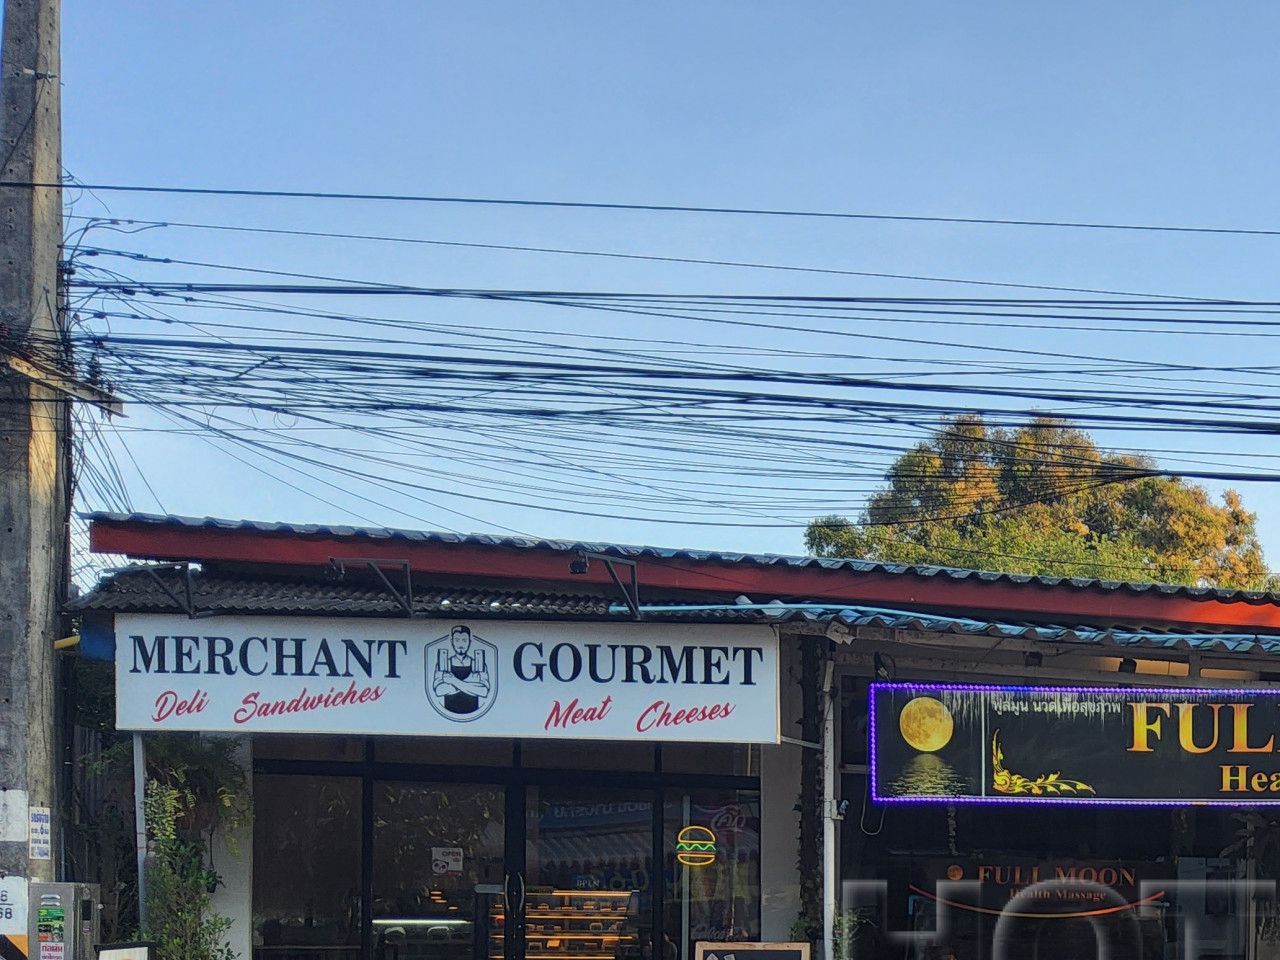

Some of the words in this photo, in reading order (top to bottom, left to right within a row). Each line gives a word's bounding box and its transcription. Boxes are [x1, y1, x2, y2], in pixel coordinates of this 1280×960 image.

[128, 635, 407, 679] MERCHANT
[512, 642, 763, 686] GOURMET
[152, 689, 209, 722] Deli
[234, 681, 386, 723] Sandwiches
[544, 696, 612, 731] Meat
[636, 700, 737, 733] Cheeses
[977, 864, 1041, 885] FULL
[1055, 866, 1136, 888] MOON
[1055, 889, 1107, 903] Massage
